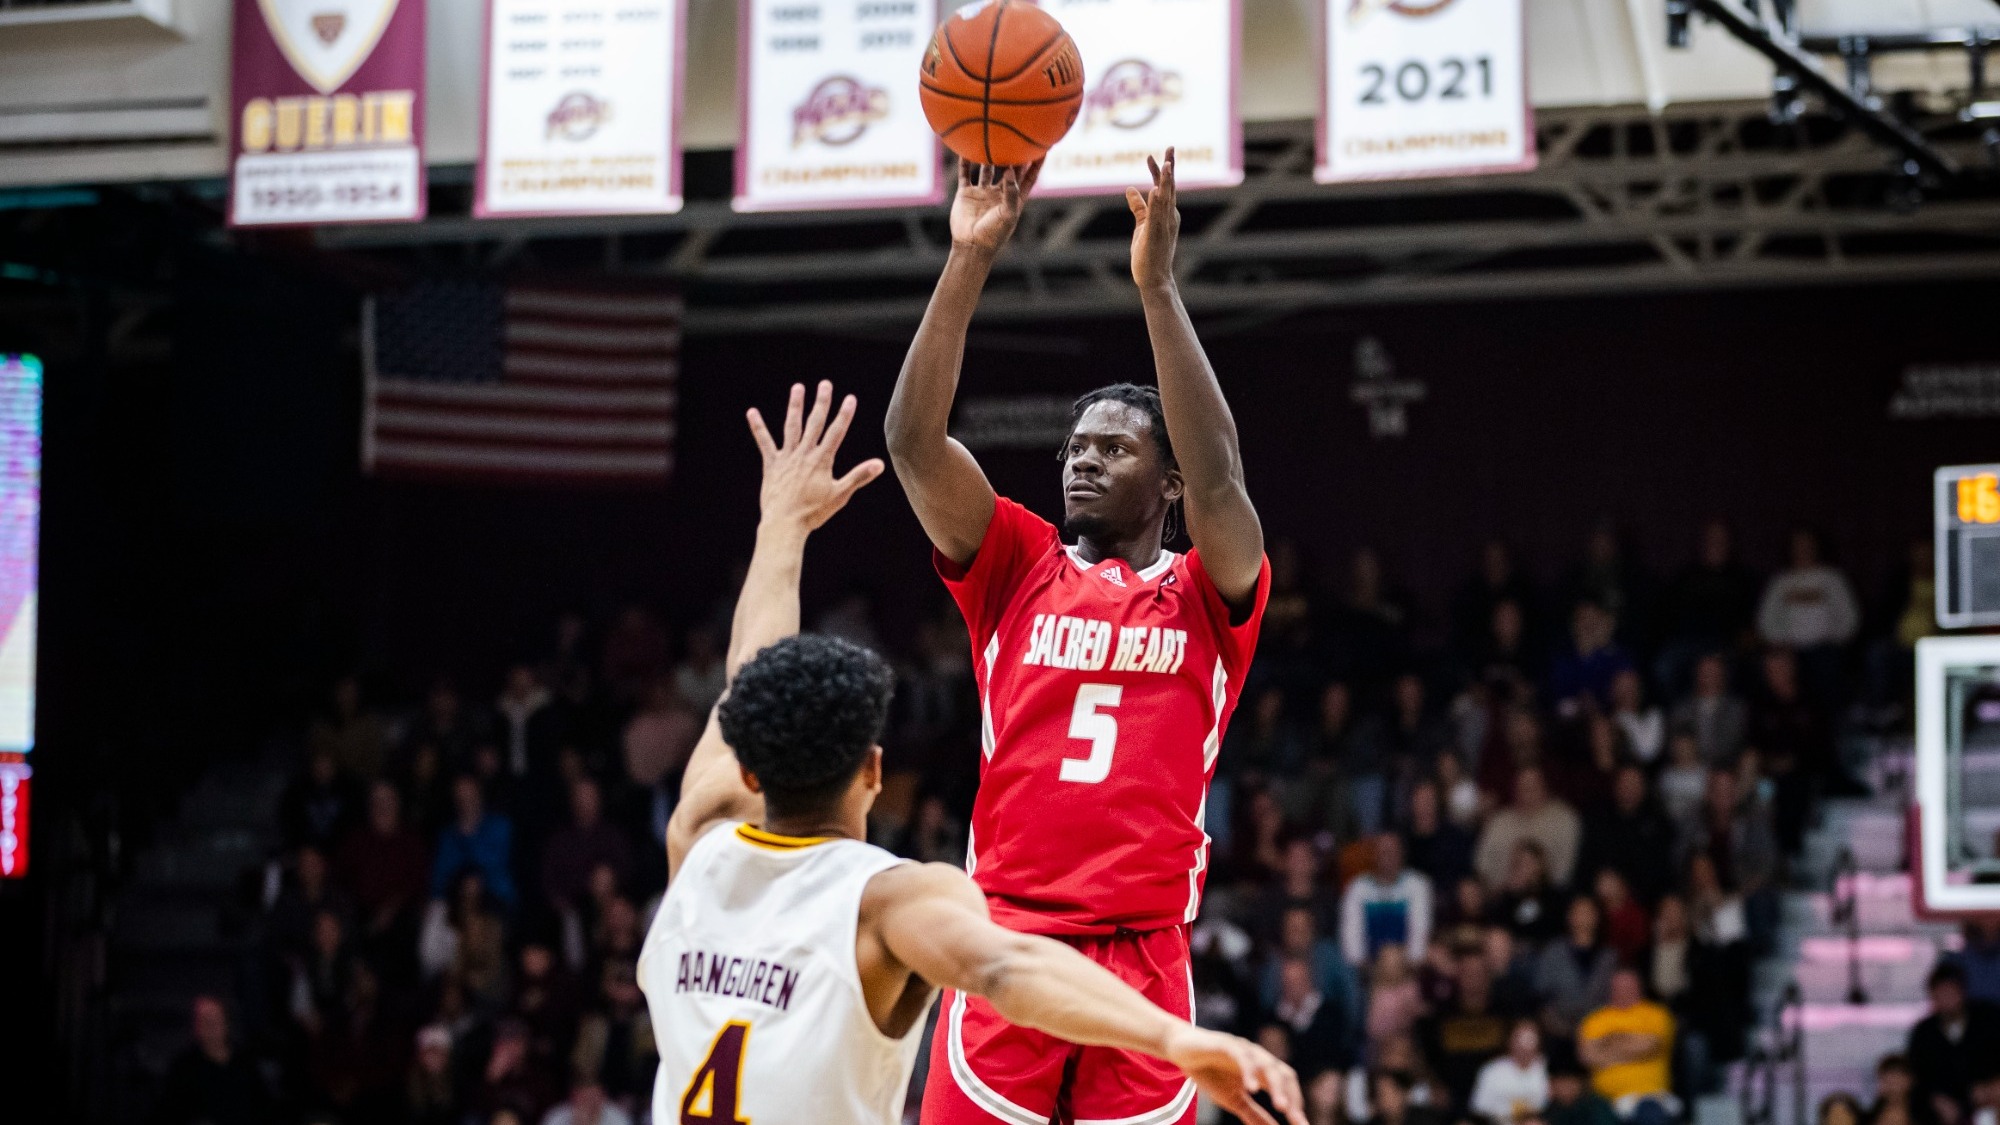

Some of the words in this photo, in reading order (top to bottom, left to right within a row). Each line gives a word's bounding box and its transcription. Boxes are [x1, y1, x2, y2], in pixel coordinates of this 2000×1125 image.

[1358, 57, 1494, 105] 2021
[241, 91, 414, 152] GUERIN
[1023, 613, 1112, 671] SACRED
[1109, 625, 1187, 675] HEART
[1058, 682, 1124, 784] 5
[680, 1019, 752, 1125] 4
